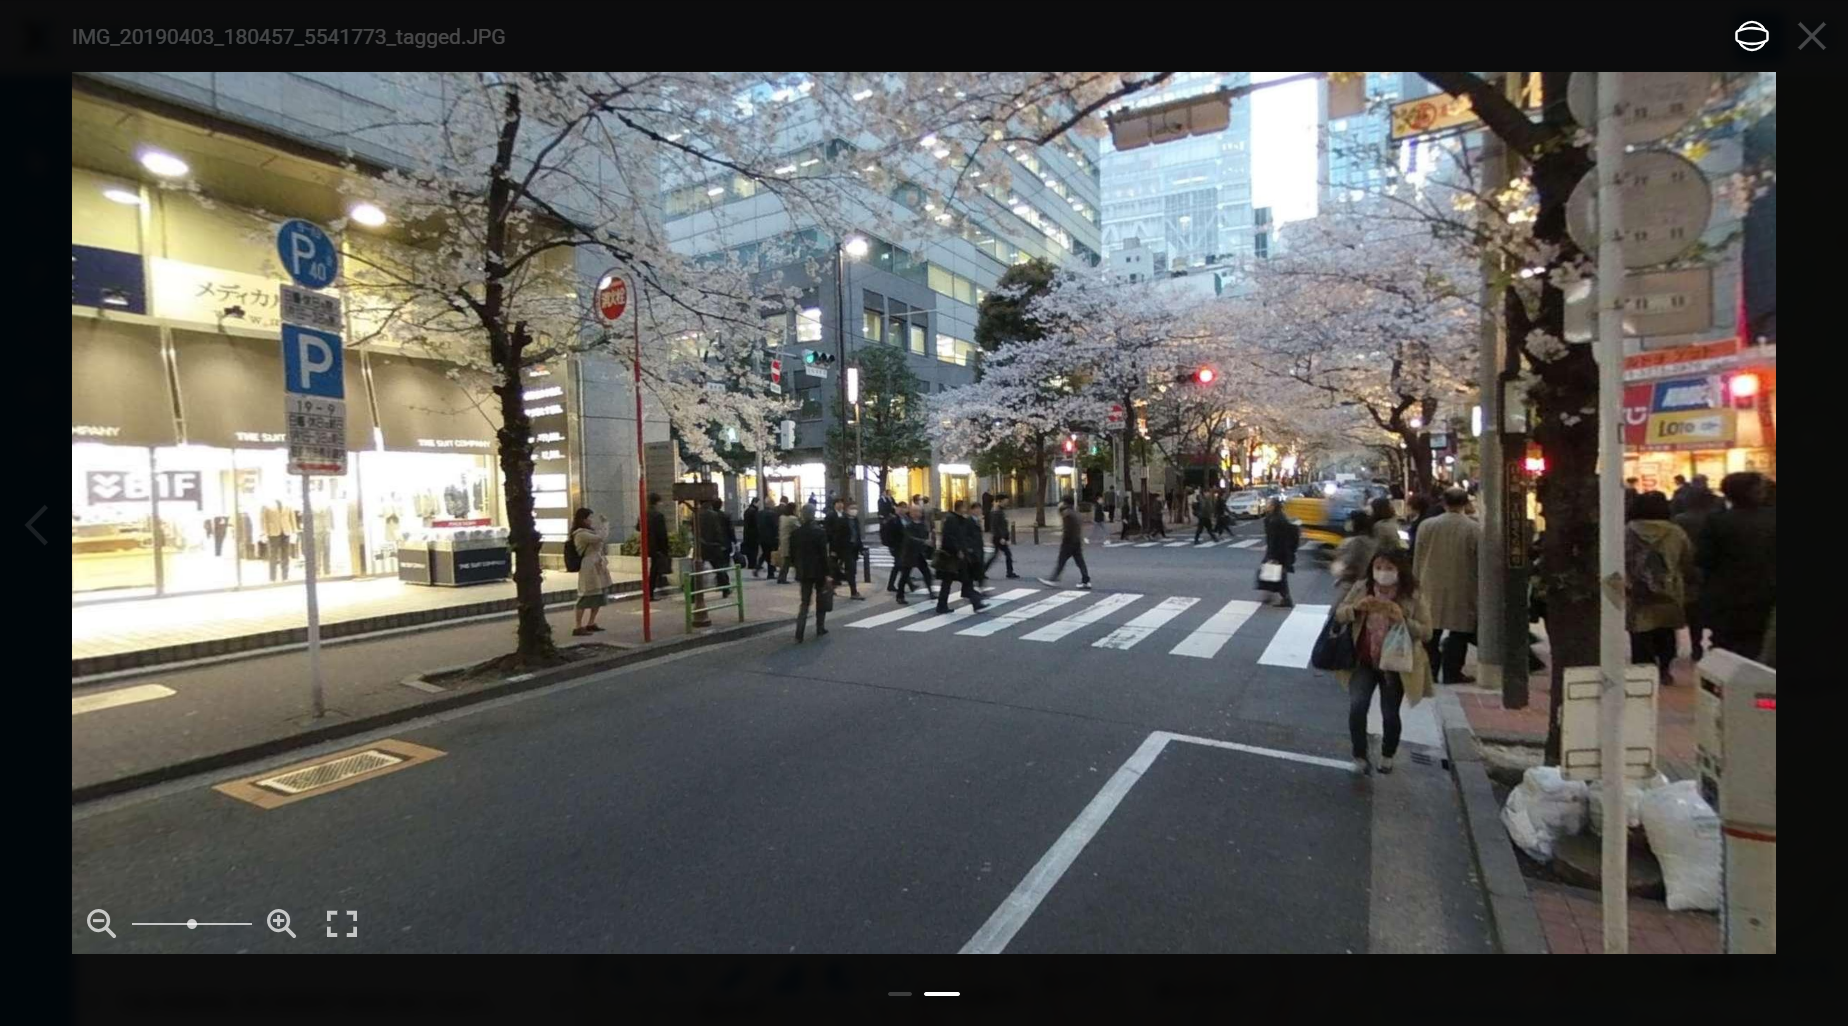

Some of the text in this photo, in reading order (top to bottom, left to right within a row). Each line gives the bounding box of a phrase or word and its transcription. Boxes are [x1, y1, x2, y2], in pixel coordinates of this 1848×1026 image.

[291, 231, 316, 275] P
[308, 261, 327, 281] 40
[298, 332, 333, 389] P
[235, 431, 260, 442] THE
[261, 432, 287, 442] SUIT
[417, 438, 491, 448] THE SUIT COMPANY
[124, 472, 197, 499] B1F
